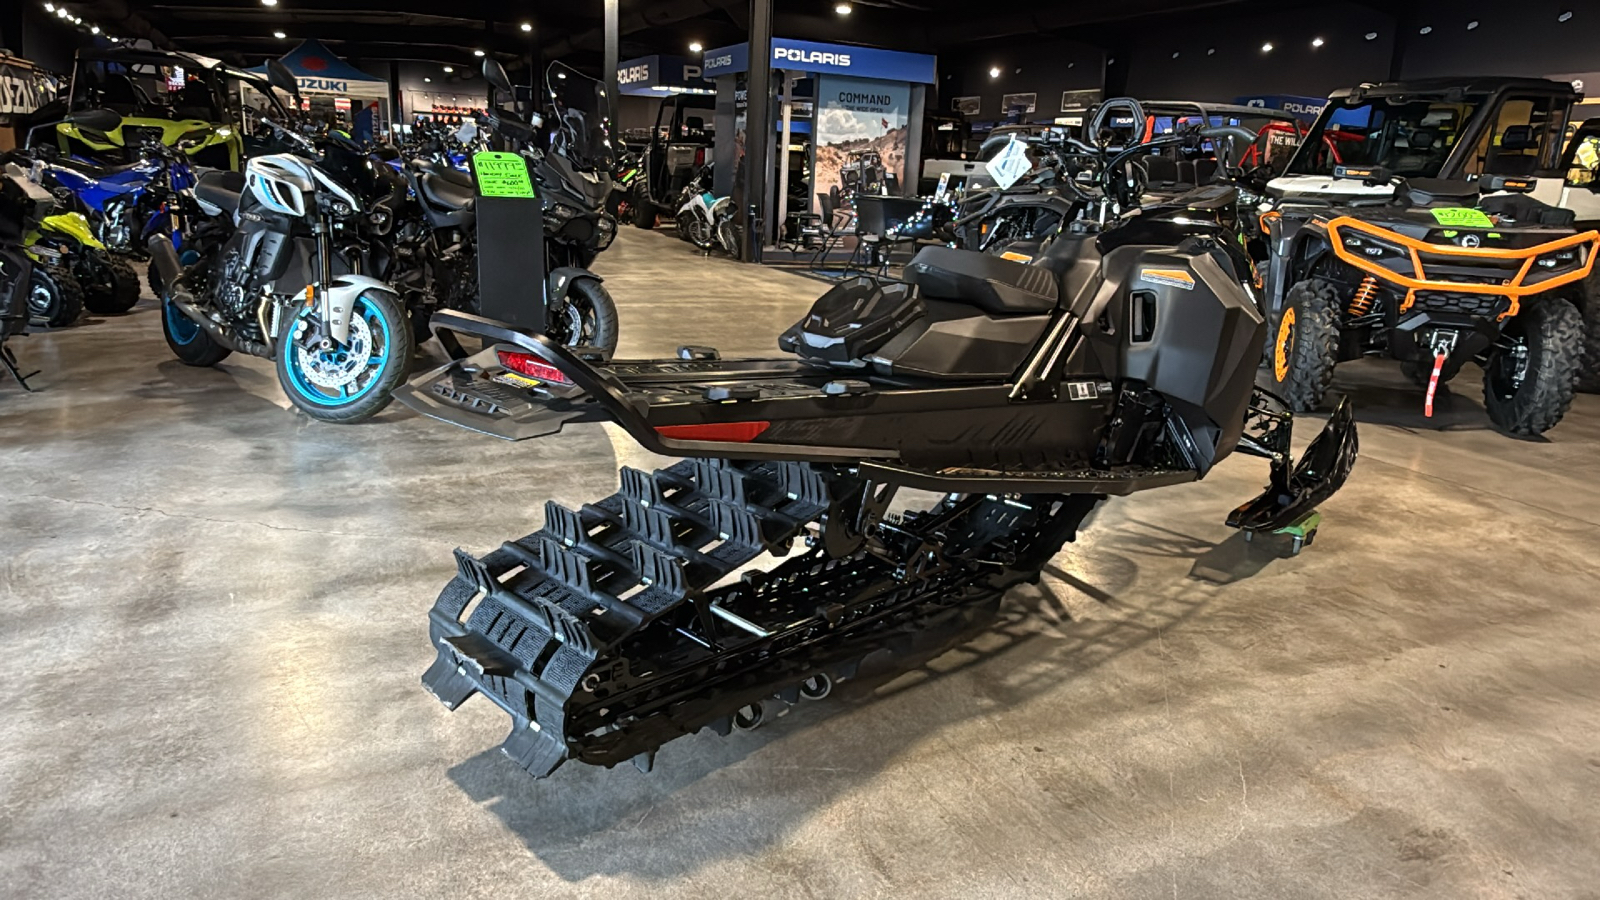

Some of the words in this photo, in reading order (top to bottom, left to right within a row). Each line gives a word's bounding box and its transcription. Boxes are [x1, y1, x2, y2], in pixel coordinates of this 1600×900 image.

[704, 54, 732, 70] POLARIS
[774, 47, 851, 66] POLARIS
[296, 78, 347, 92] UZUKI
[838, 91, 891, 106] COMMAND
[1270, 134, 1287, 145] THE
